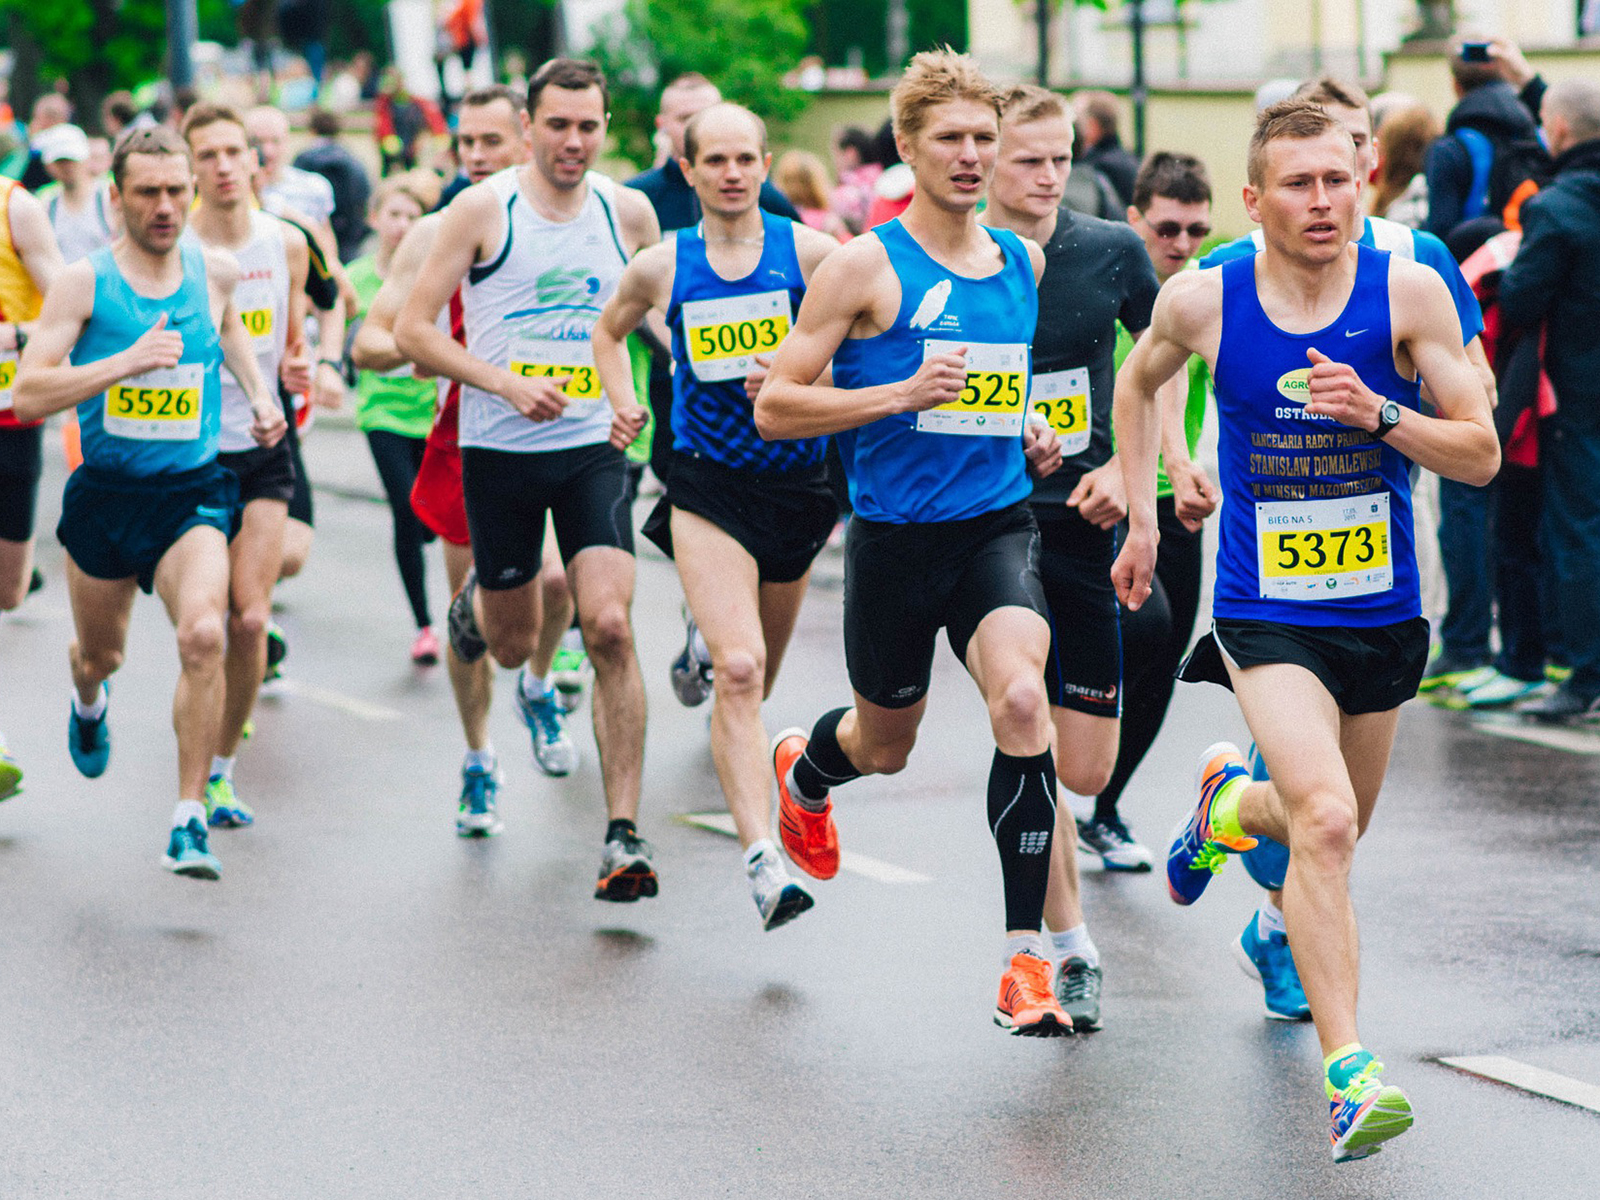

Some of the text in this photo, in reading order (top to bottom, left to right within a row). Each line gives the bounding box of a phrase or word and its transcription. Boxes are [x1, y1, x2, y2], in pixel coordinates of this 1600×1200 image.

[699, 319, 778, 355] 5003
[118, 387, 191, 416] 5526
[960, 372, 1020, 407] 525
[1250, 432, 1303, 449] KANCELARIA
[1305, 433, 1334, 449] RADCY
[1251, 483, 1261, 497] W
[1268, 515, 1289, 525] BIEG
[1307, 515, 1313, 524] 5
[1277, 526, 1375, 570] 5373
